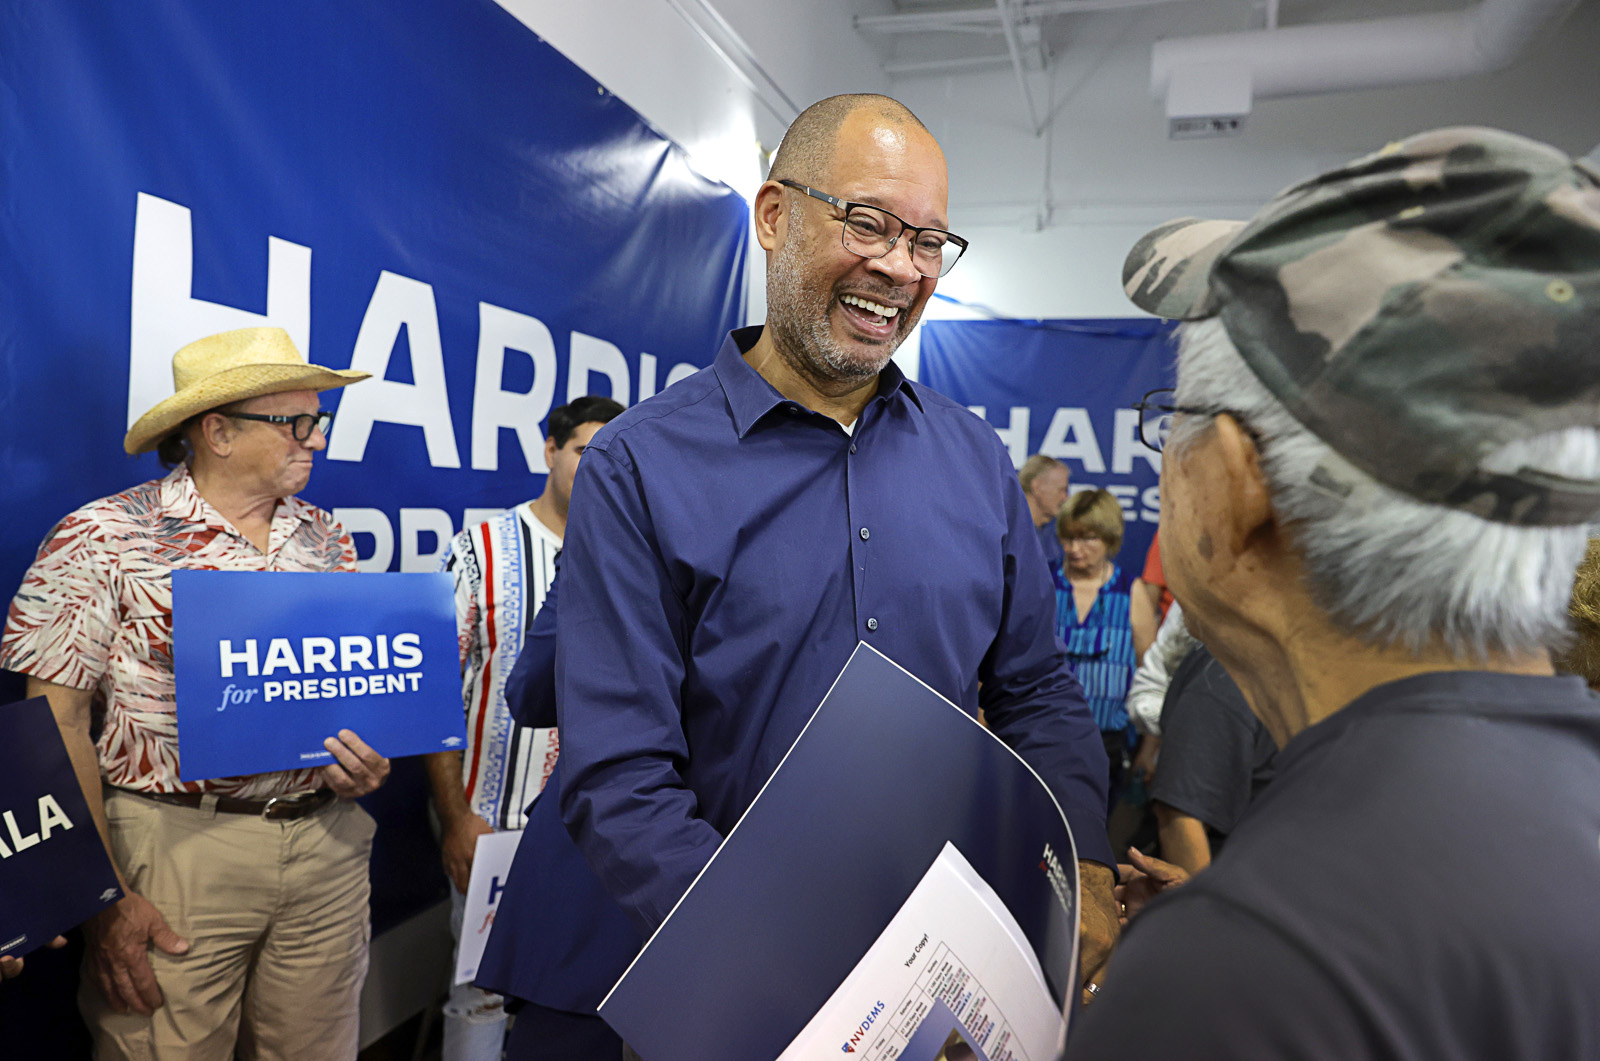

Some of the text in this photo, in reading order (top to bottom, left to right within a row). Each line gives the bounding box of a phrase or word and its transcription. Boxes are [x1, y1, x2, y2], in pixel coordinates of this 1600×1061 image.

[127, 191, 700, 474] HARR
[967, 406, 1161, 474] HAR
[219, 633, 423, 677] HARRIS
[216, 672, 423, 712] for PRESIDENT
[904, 933, 929, 968] Your Copy!
[850, 1000, 885, 1046] NVDEMS
